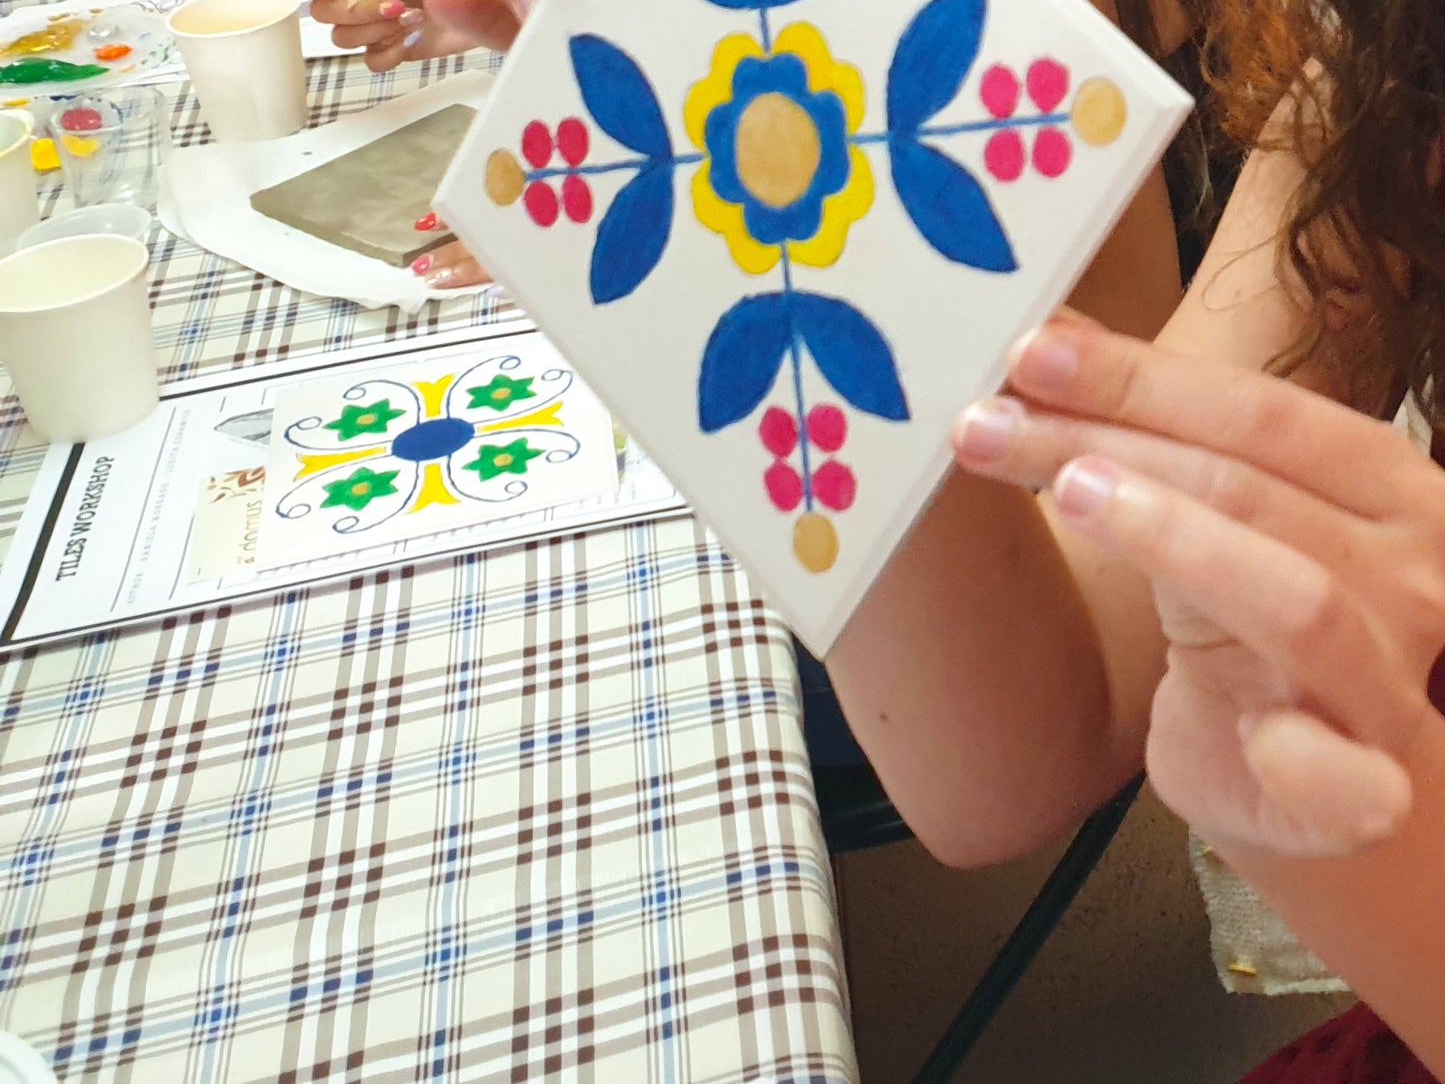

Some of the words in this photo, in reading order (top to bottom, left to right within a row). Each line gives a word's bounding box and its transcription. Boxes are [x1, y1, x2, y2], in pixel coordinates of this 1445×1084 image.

[70, 455, 115, 538] WORKSHOP
[238, 499, 262, 552] domus
[55, 537, 87, 582] TILES
